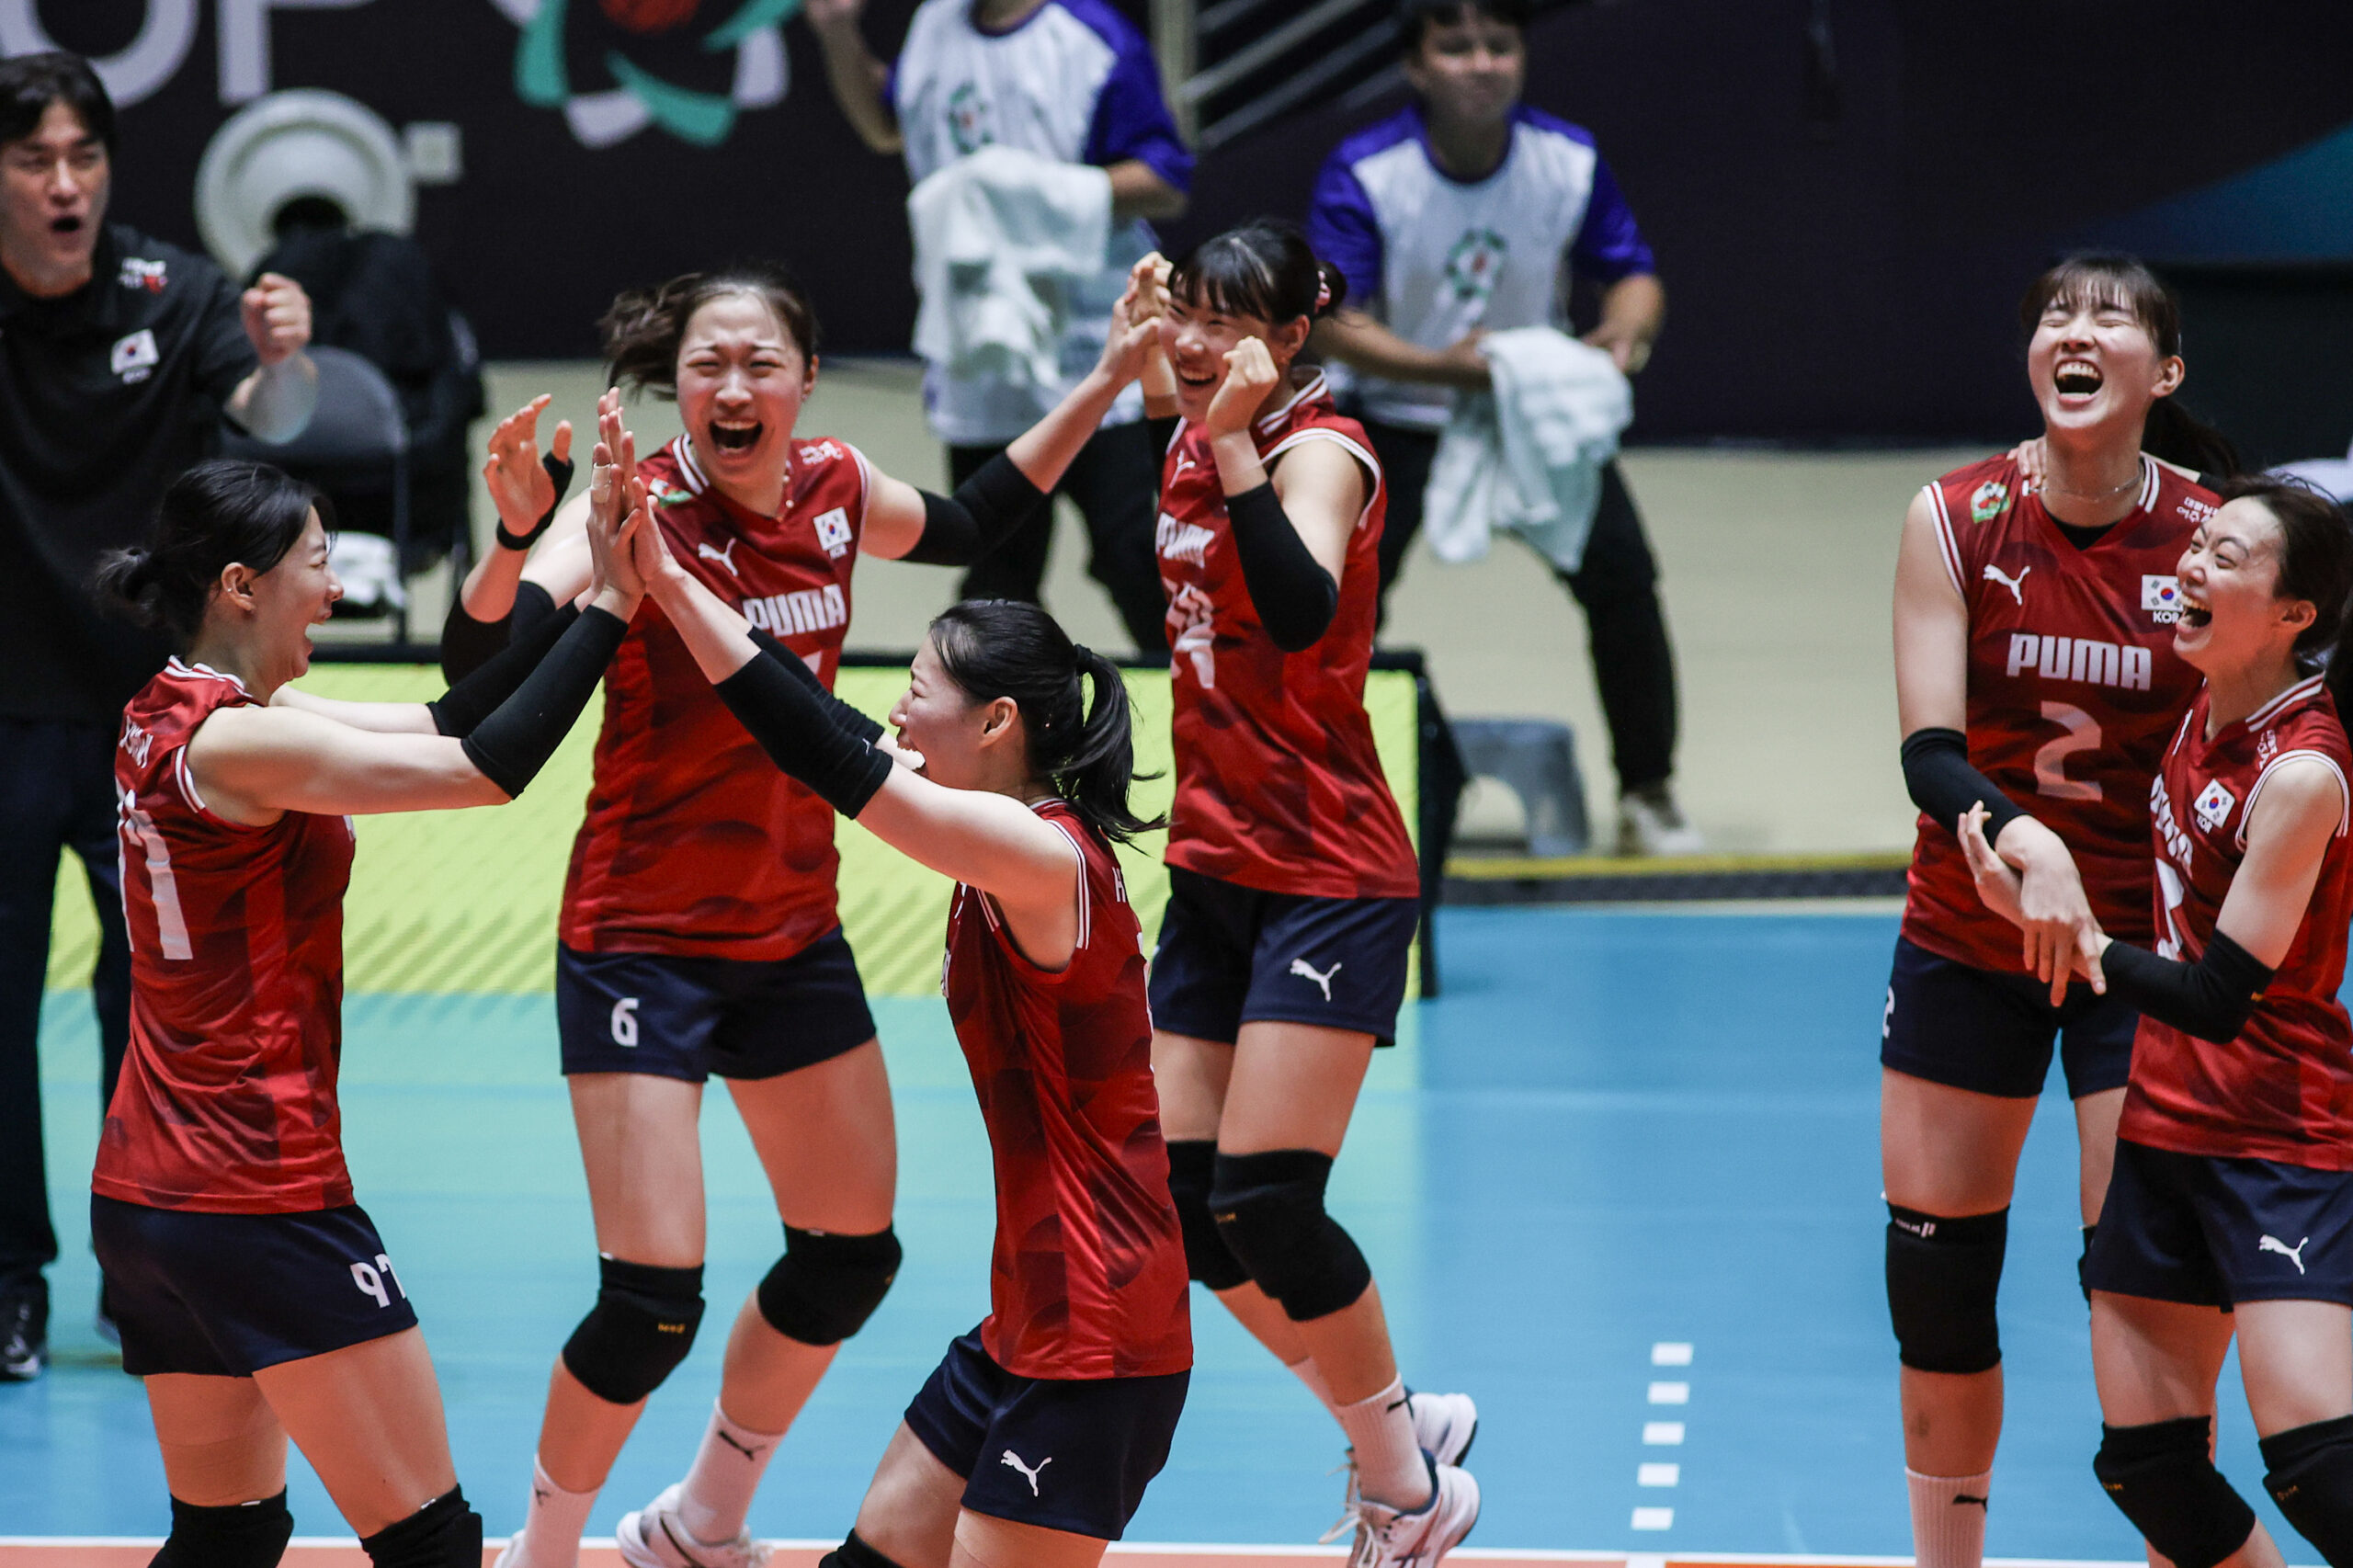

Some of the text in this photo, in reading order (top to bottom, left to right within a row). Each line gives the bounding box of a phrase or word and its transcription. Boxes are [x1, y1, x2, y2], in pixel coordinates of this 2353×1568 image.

[742, 584, 846, 636] PUMA
[2153, 610, 2179, 624] KOR
[2006, 633, 2152, 691] PUMA
[2033, 699, 2103, 803] 2
[610, 997, 639, 1047] 6
[349, 1253, 407, 1309] 97
